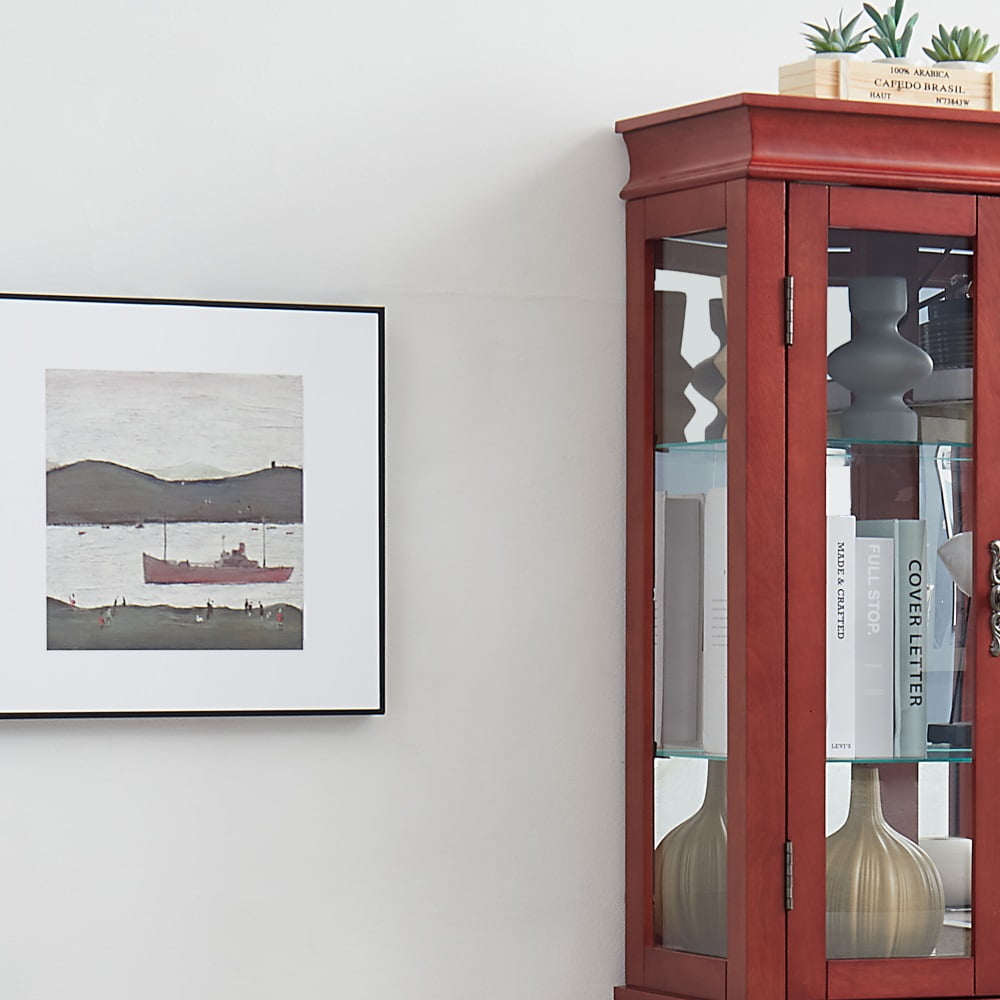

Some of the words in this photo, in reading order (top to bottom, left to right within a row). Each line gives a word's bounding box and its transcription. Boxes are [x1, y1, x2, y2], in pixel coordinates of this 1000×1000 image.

[890, 66, 910, 75] 100%
[913, 68, 950, 79] ARABICA
[924, 83, 966, 94] BRASIL
[869, 91, 891, 100] HAUT
[837, 541, 845, 574] MADE
[867, 544, 880, 585] FULL
[837, 576, 845, 585] &
[908, 559, 922, 627] COVER
[837, 588, 845, 640] CRAFTED
[909, 633, 923, 707] LETTER
